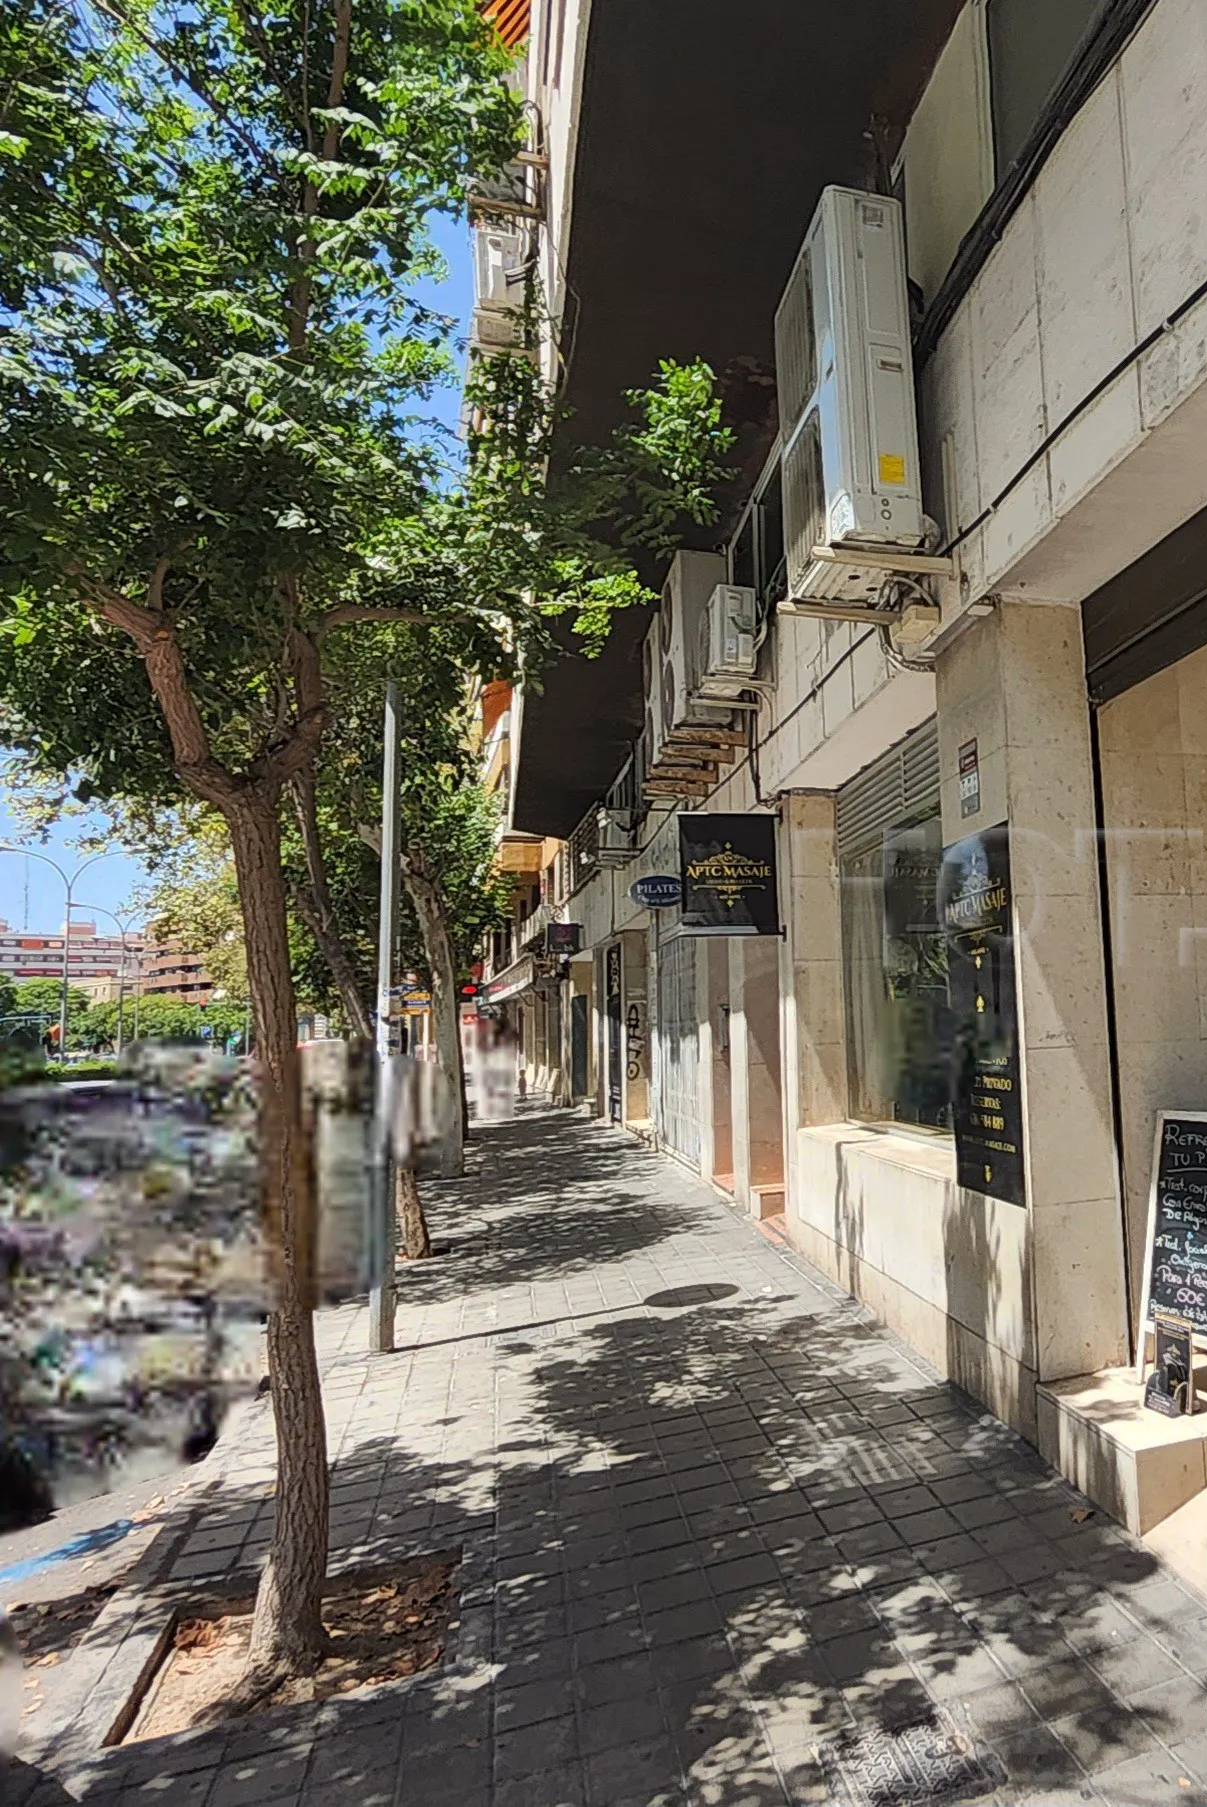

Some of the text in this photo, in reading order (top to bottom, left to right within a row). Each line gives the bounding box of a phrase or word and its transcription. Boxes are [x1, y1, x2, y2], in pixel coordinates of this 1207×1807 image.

[723, 865, 773, 879] MASAJE
[636, 884, 683, 895] PILATES
[971, 887, 1008, 917] MASAJE
[1168, 1152, 1191, 1167] TU
[1176, 1287, 1206, 1306] 60€
